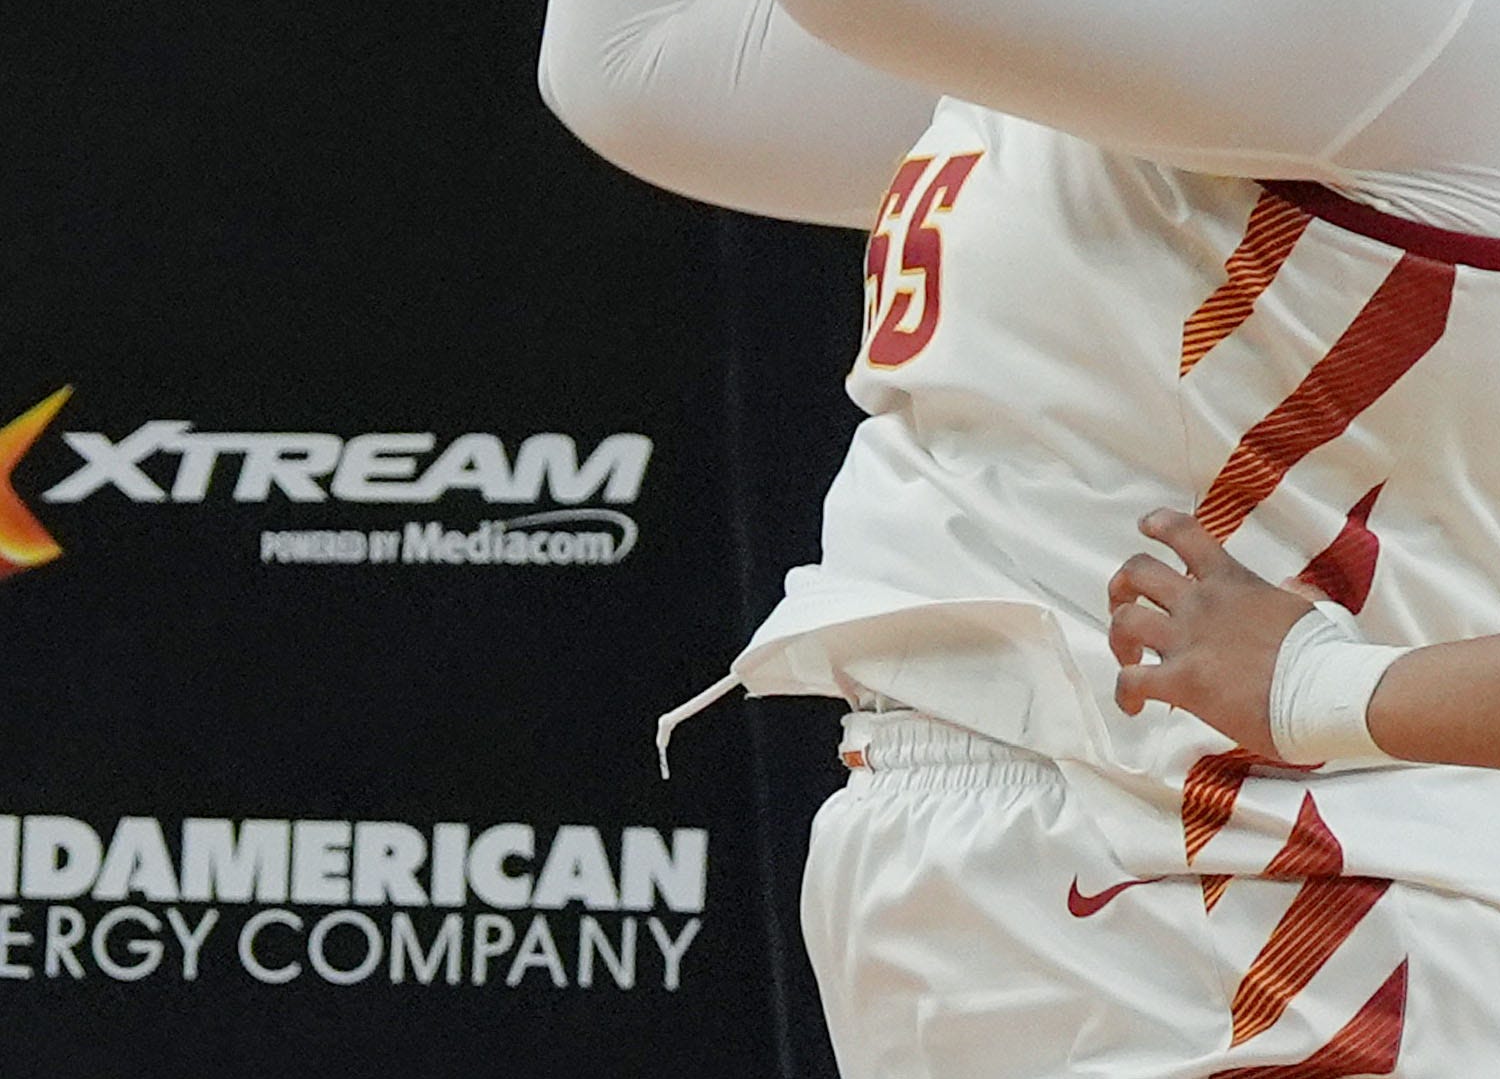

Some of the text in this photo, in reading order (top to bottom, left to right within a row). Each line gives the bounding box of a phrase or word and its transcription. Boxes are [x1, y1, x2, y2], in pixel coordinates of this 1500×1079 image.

[42, 420, 654, 504] XTREAM
[402, 520, 614, 564] Mediacom
[0, 904, 701, 990] ERGY COMPANY
